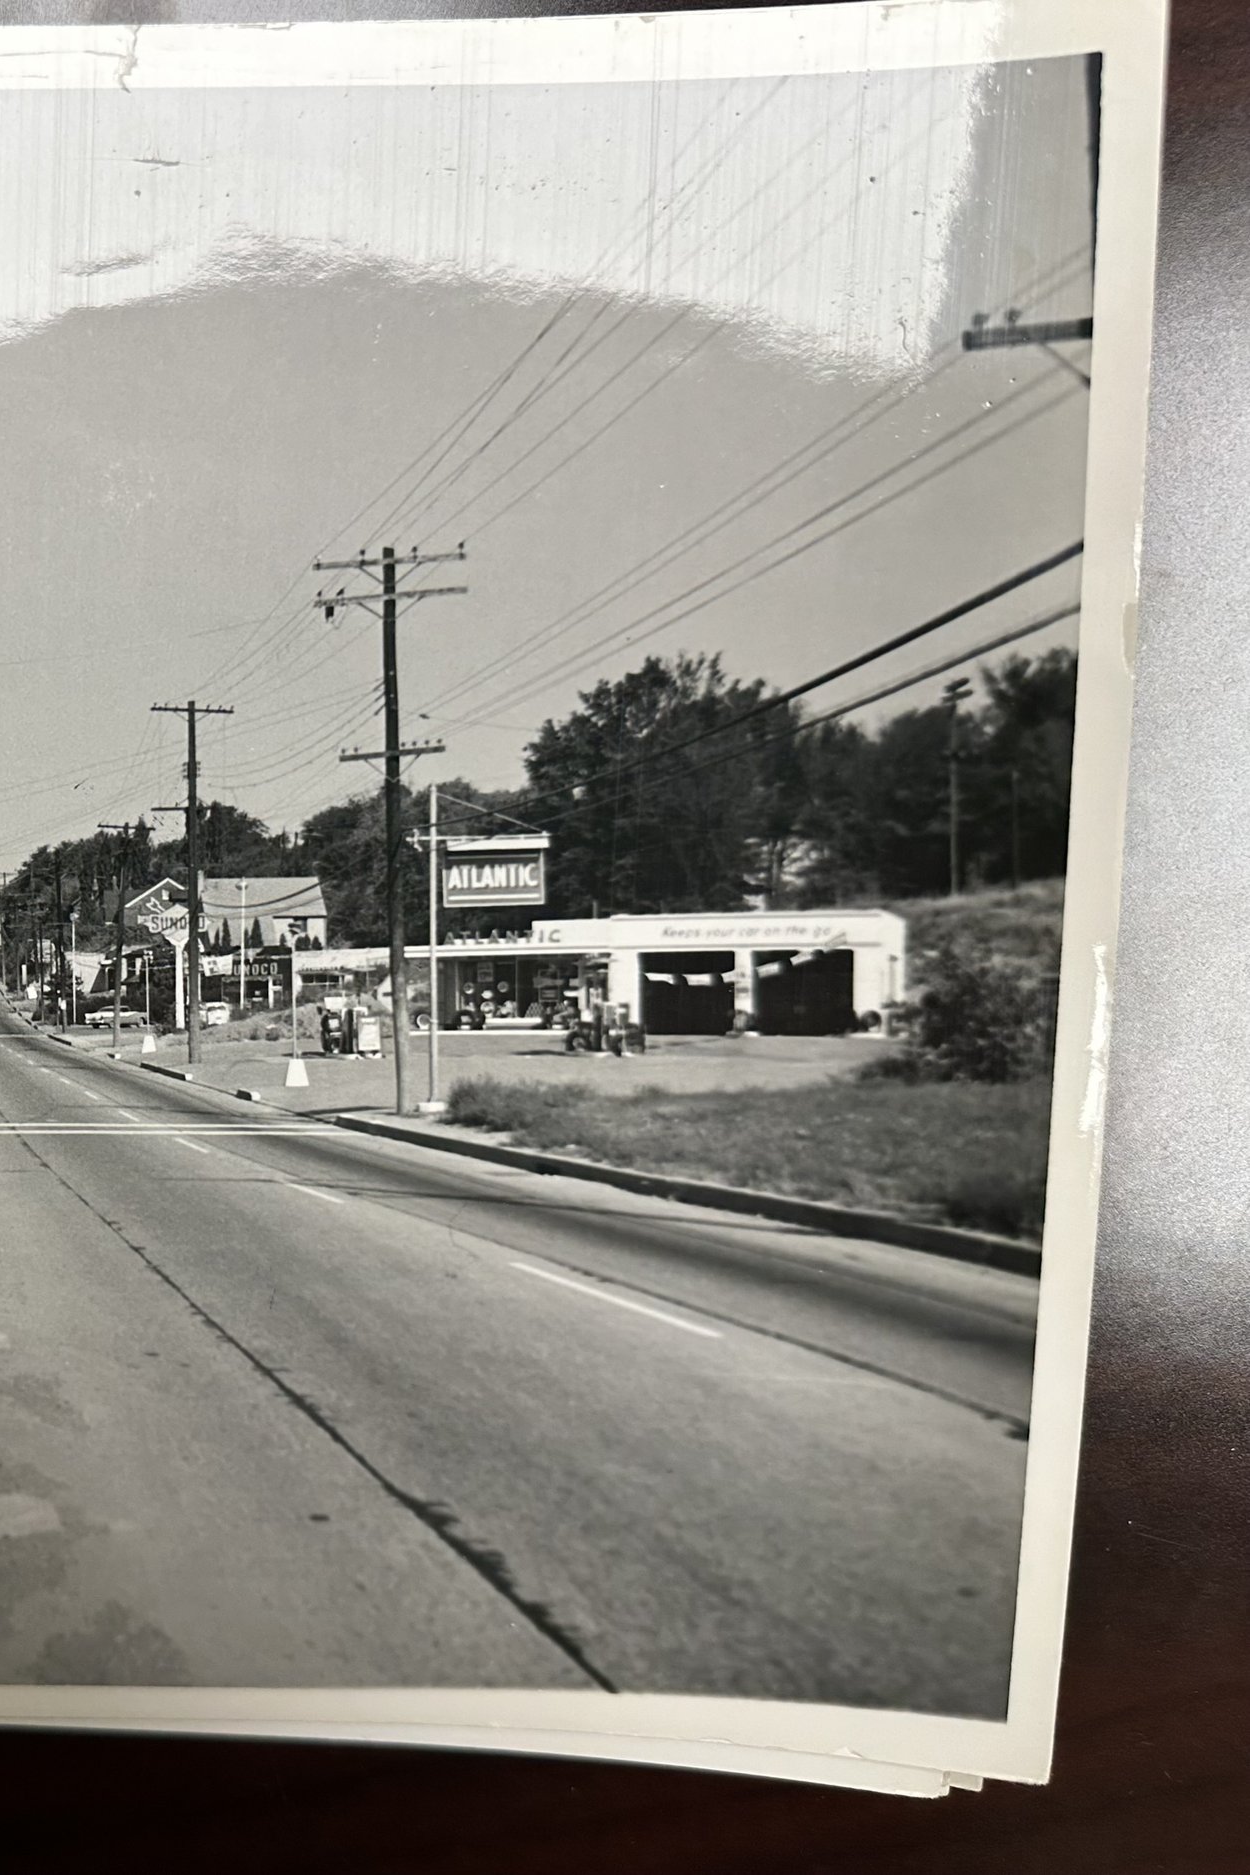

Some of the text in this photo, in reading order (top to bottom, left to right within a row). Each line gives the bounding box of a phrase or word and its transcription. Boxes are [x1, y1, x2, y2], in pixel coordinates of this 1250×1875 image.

[448, 863, 538, 889] ATLANTIC
[151, 915, 205, 931] SUNOO
[443, 929, 561, 946] ATLANTIC
[662, 925, 832, 939] Keeps your car on the go
[233, 962, 278, 975] UNOCO
